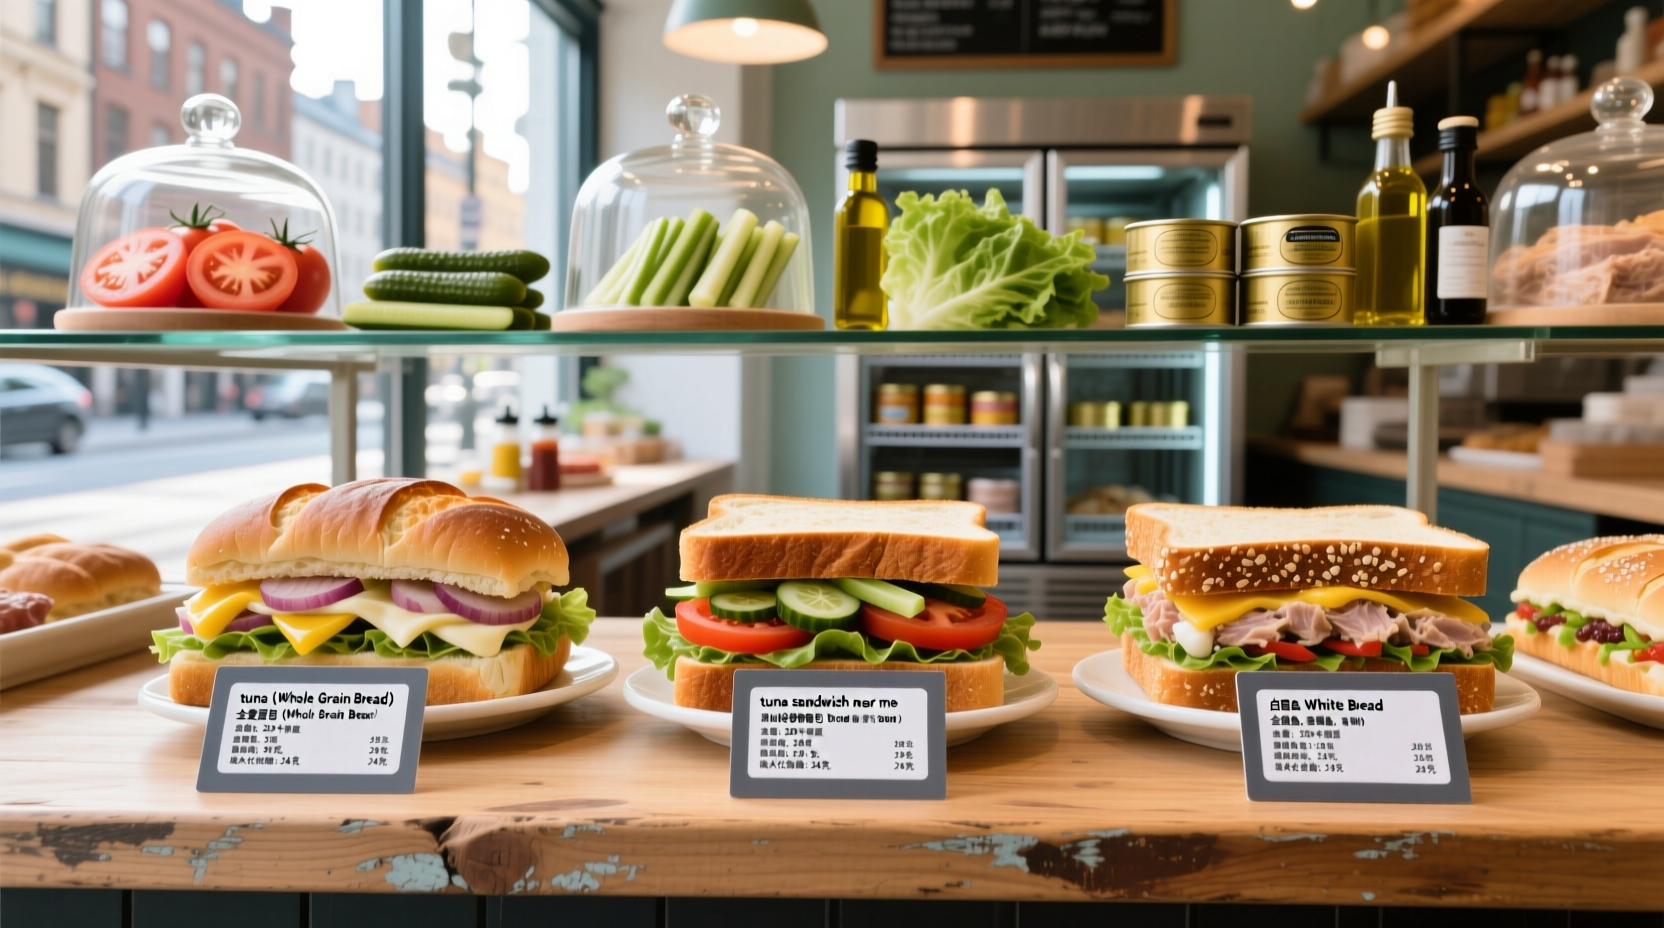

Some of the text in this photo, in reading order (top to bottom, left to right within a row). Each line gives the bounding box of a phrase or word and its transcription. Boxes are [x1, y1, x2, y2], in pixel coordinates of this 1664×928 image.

[240, 690, 394, 707] tuna (Whole Grain Bread)
[759, 697, 789, 708] tuna
[791, 694, 850, 708] sandwich
[878, 699, 899, 709] me
[1304, 698, 1344, 711] White
[1347, 698, 1384, 711] Bread
